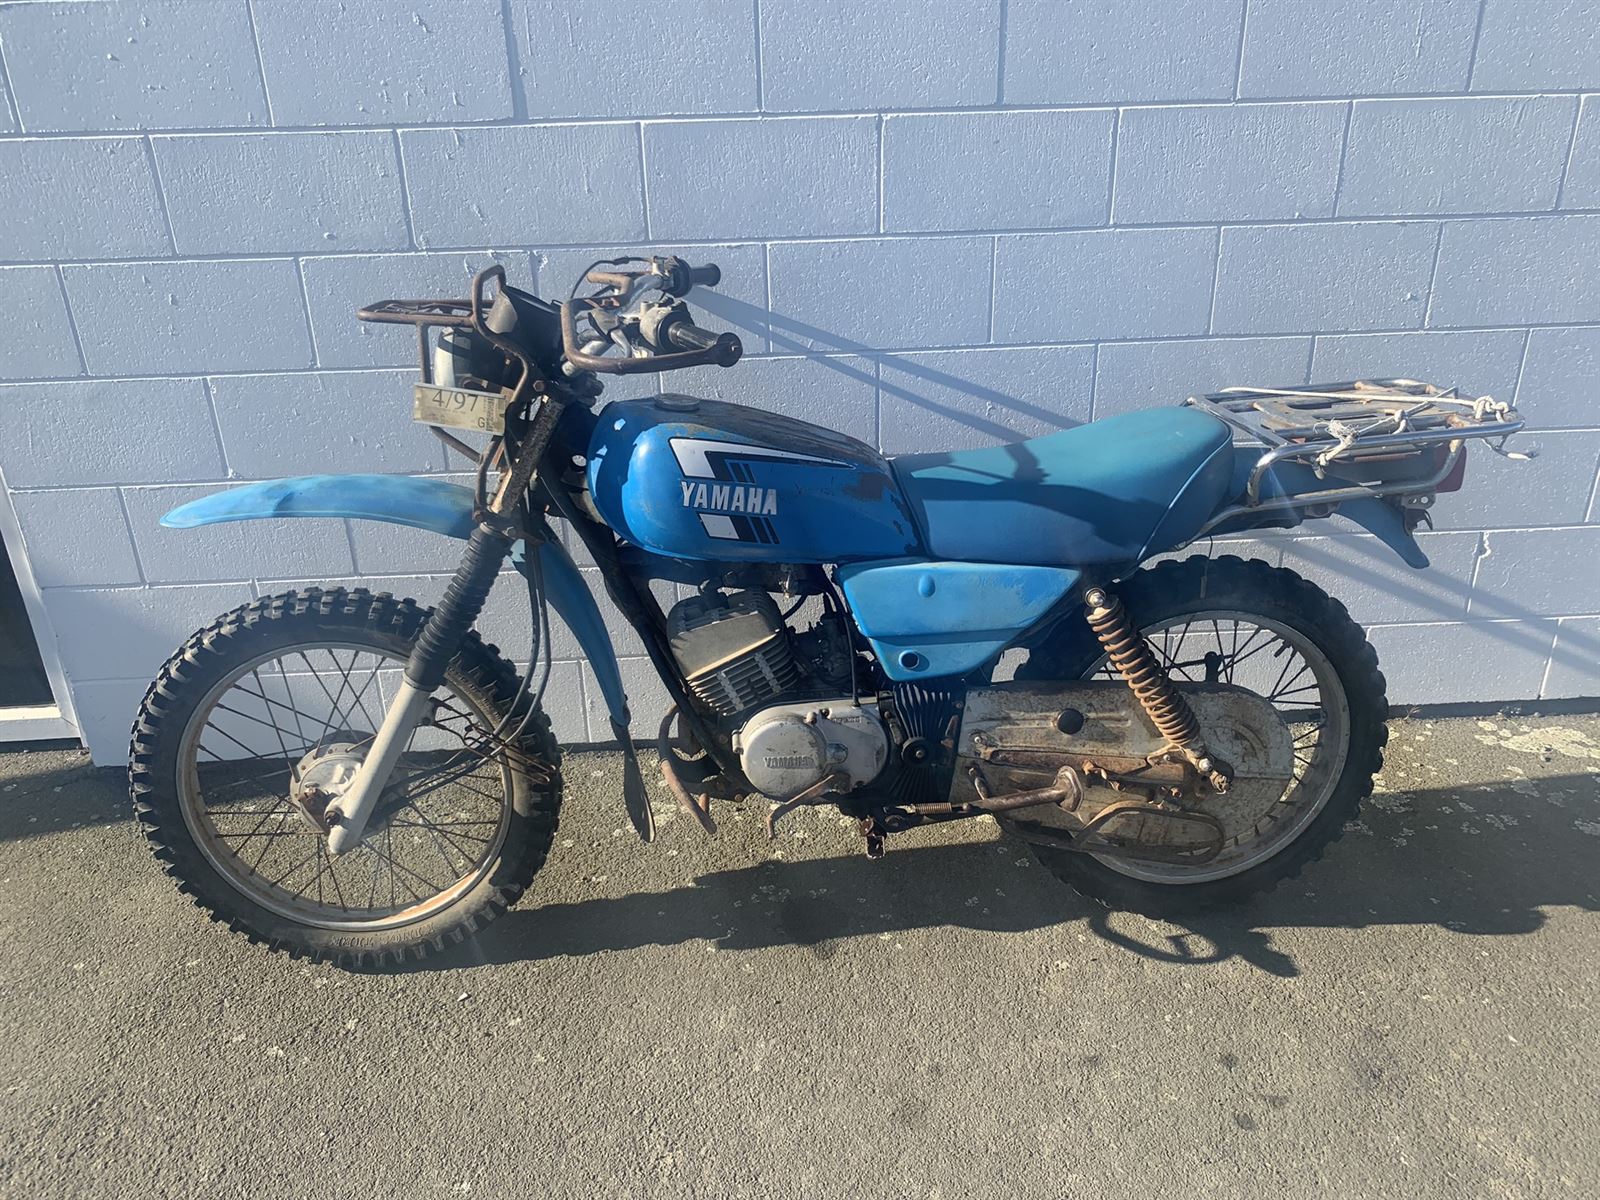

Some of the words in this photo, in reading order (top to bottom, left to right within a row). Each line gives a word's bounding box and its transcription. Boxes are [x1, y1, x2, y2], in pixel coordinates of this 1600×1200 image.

[432, 388, 479, 412] 4/97
[477, 416, 486, 429] G
[681, 481, 777, 515] YAMAHA
[763, 755, 816, 769] YAMAHA
